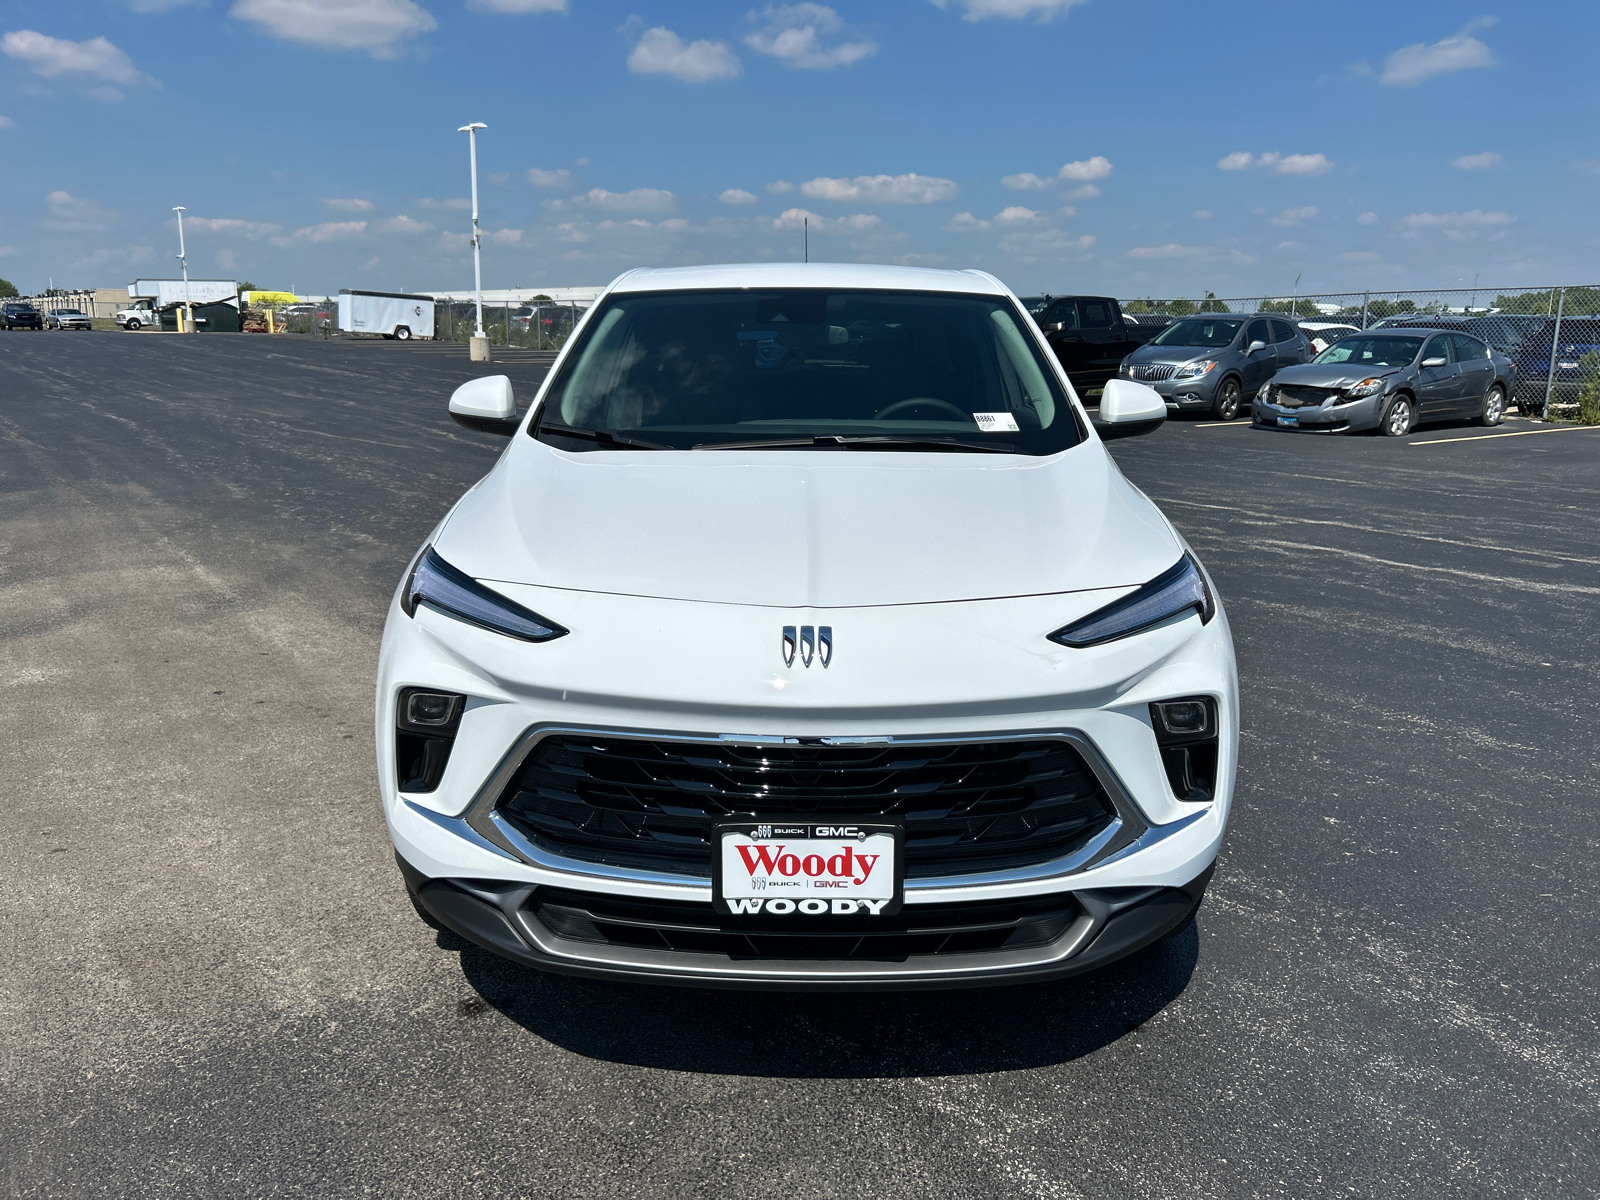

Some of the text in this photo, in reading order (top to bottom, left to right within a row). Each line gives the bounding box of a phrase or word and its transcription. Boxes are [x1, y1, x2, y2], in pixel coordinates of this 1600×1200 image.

[815, 826, 858, 837] GMC
[734, 845, 880, 886] Woody
[814, 880, 848, 888] GMC
[726, 899, 890, 914] WOODY
